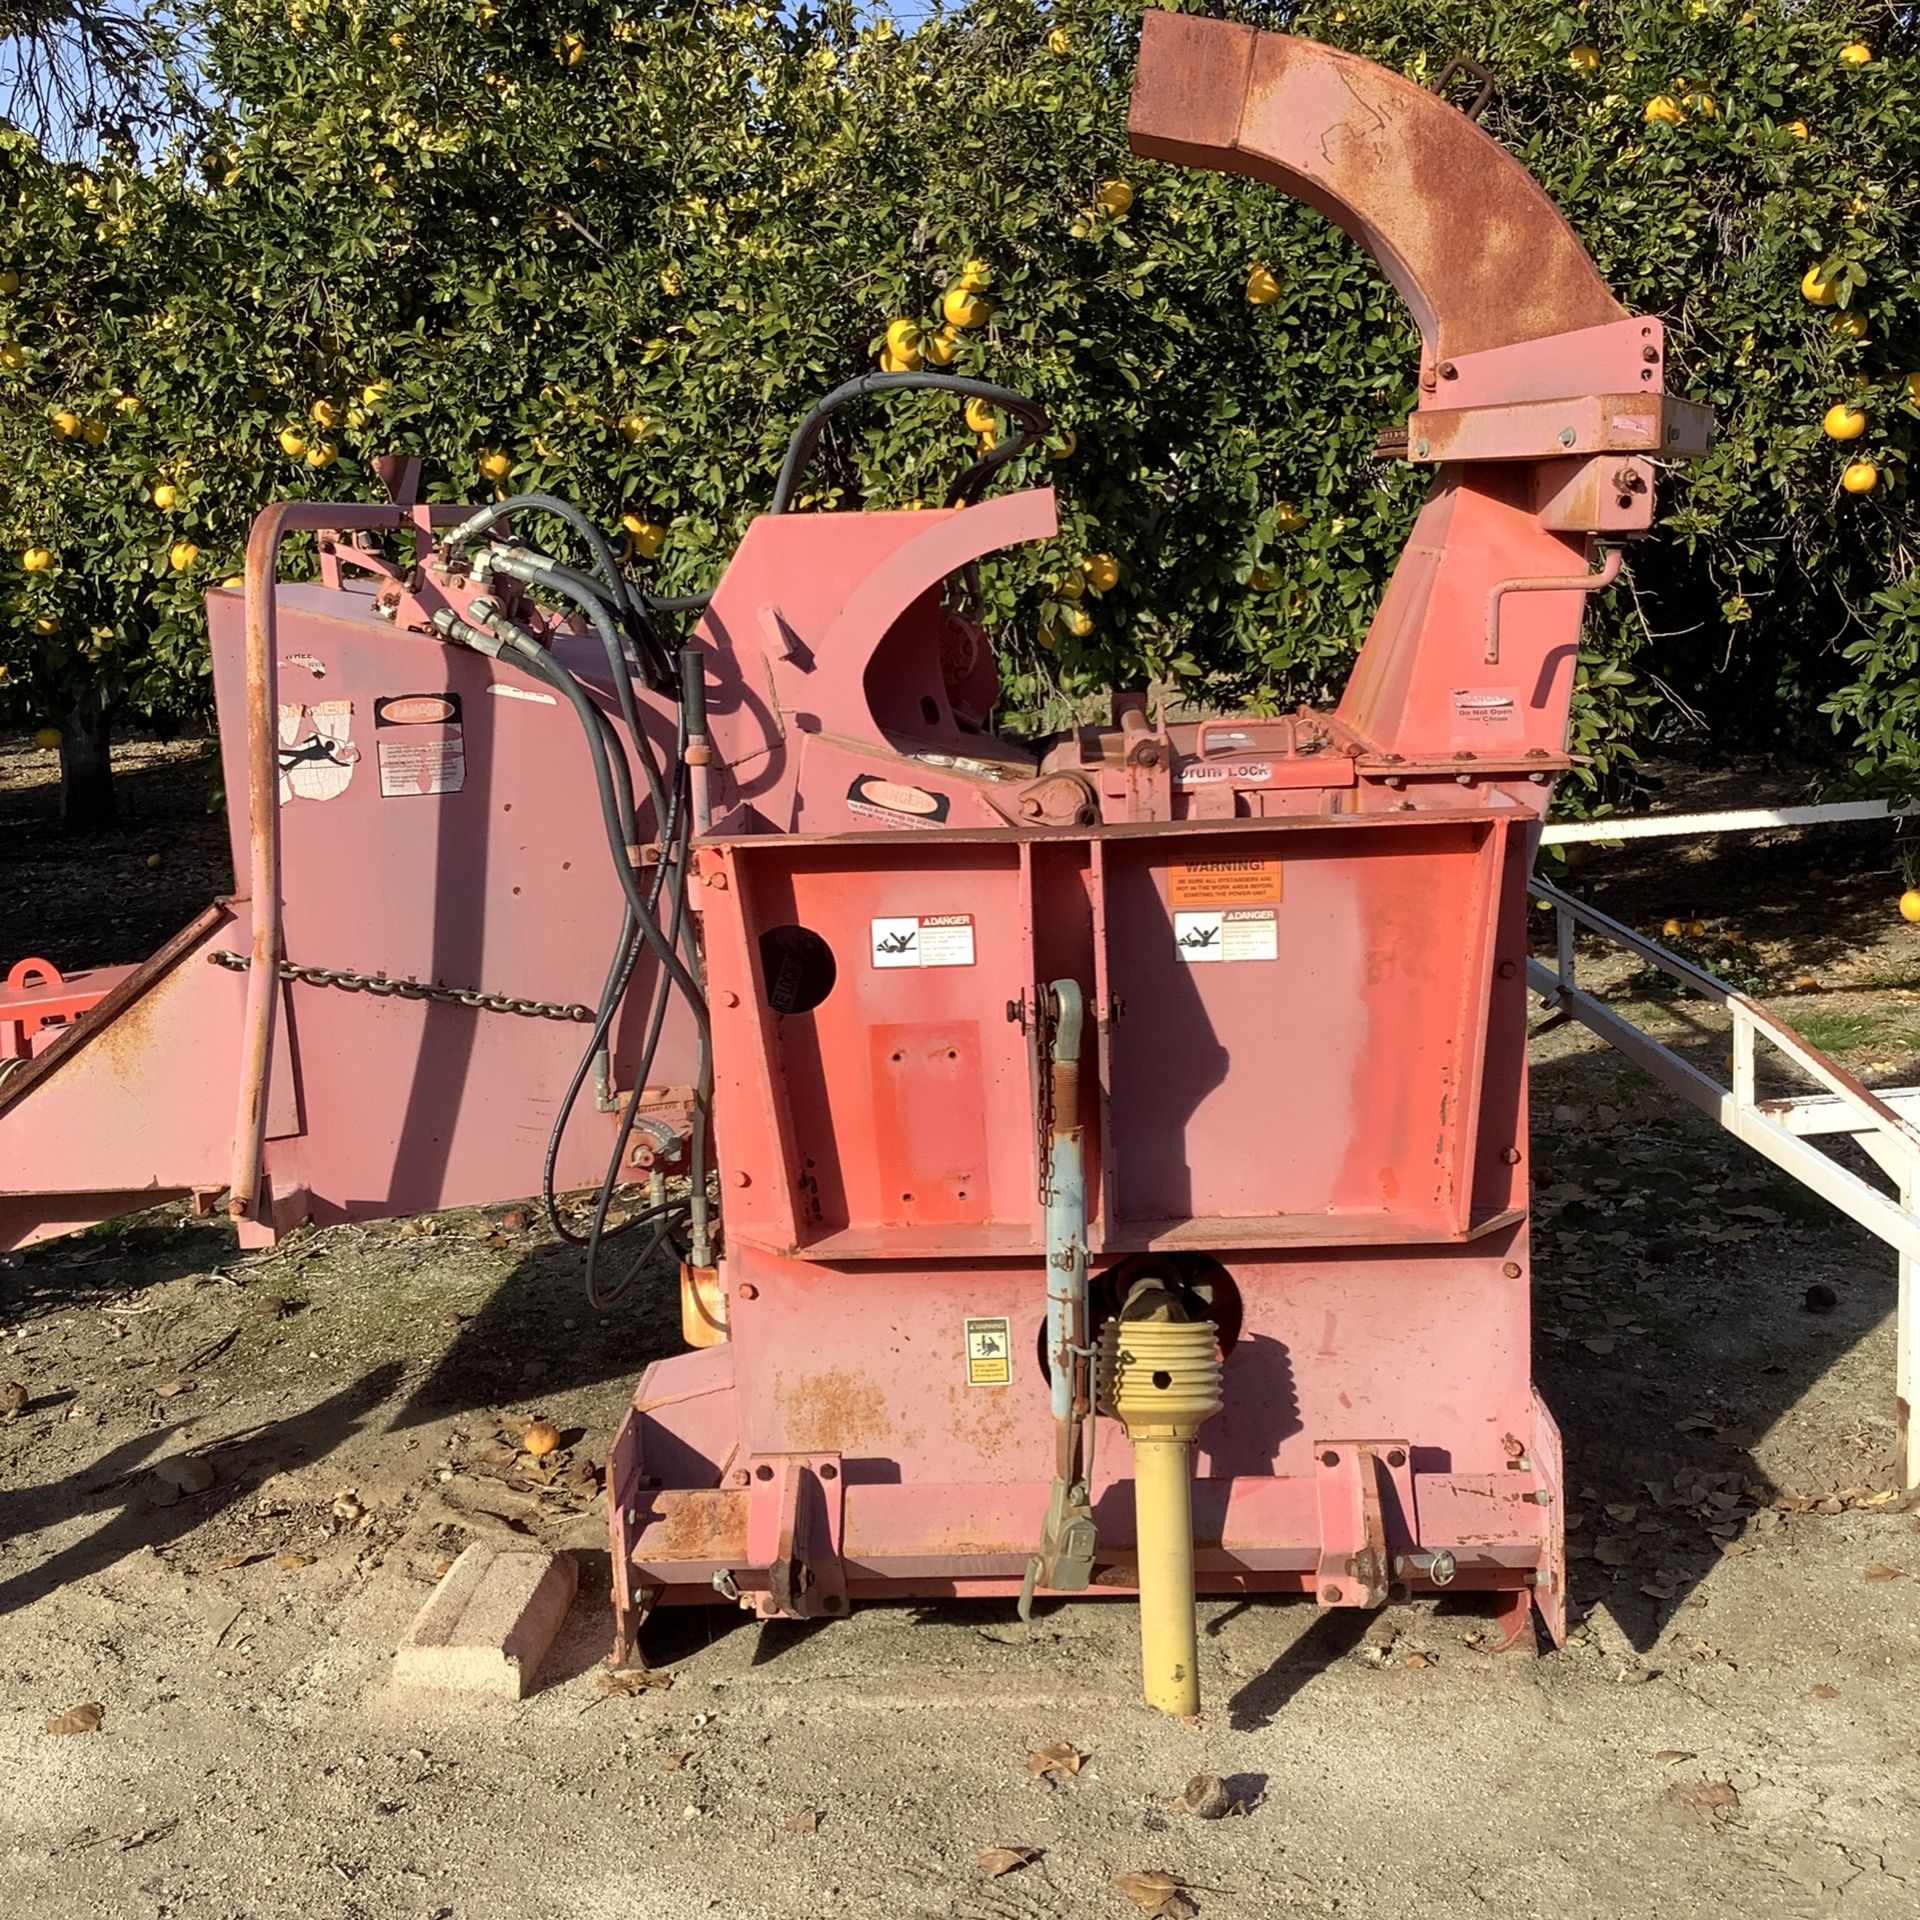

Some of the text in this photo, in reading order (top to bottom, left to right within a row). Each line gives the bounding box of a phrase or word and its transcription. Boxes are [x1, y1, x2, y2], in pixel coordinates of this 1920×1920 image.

[1490, 708, 1513, 716] Open
[1186, 860, 1265, 873] WARNING!
[930, 915, 970, 925] DANGER
[1235, 910, 1274, 920] DANGER
